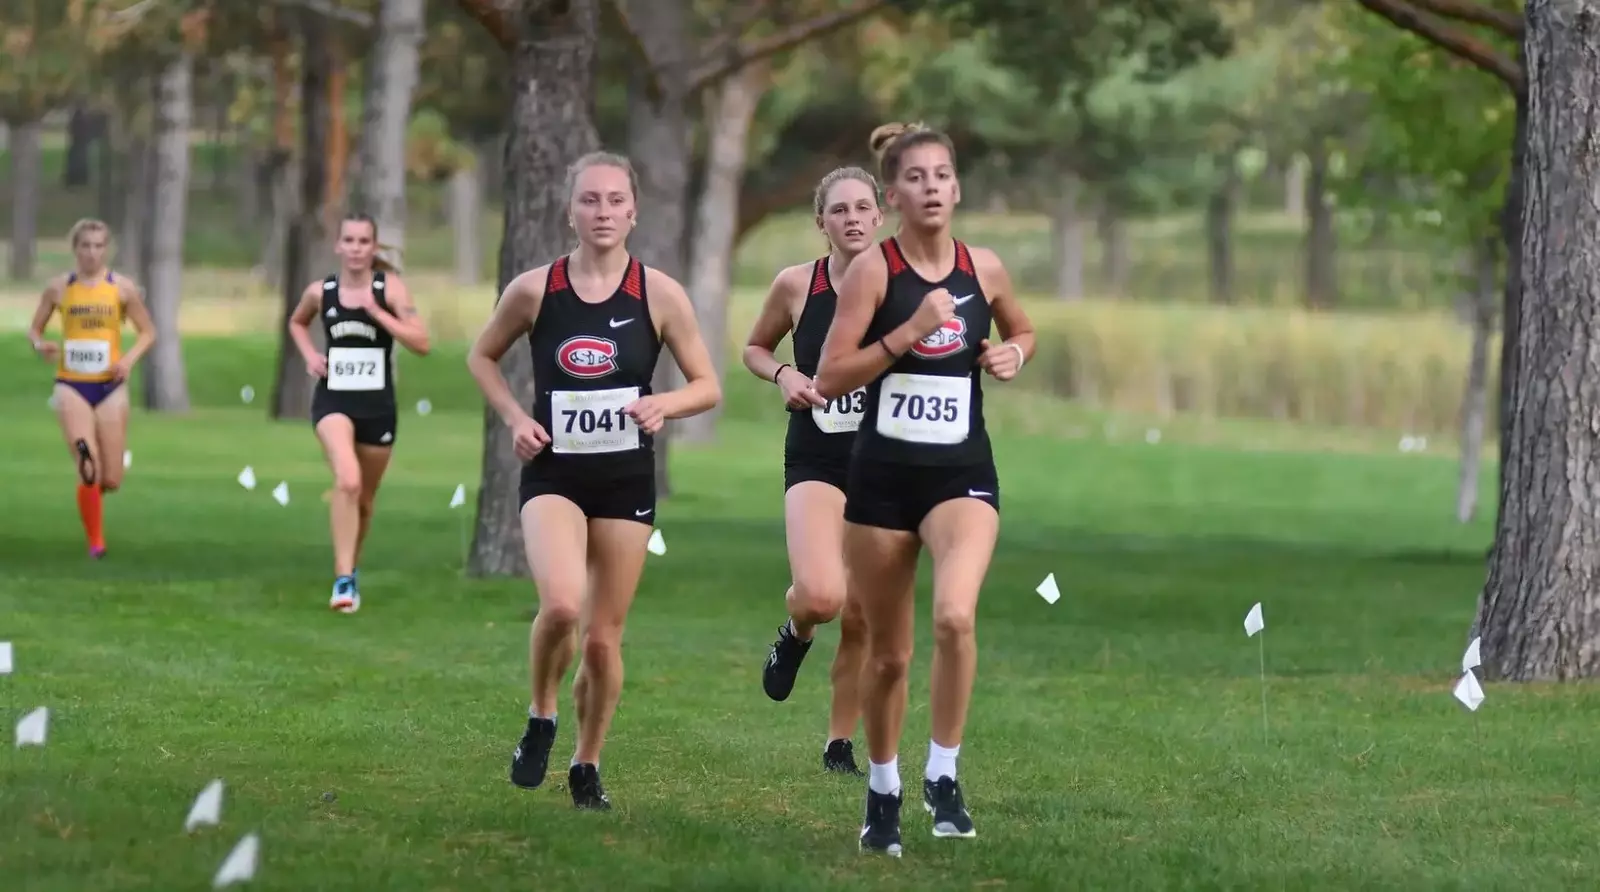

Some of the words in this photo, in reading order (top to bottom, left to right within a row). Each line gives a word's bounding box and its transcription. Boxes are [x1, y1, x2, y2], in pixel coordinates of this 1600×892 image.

[335, 361, 376, 376] 6972
[561, 407, 626, 433] 7041
[890, 393, 958, 422] 7035
